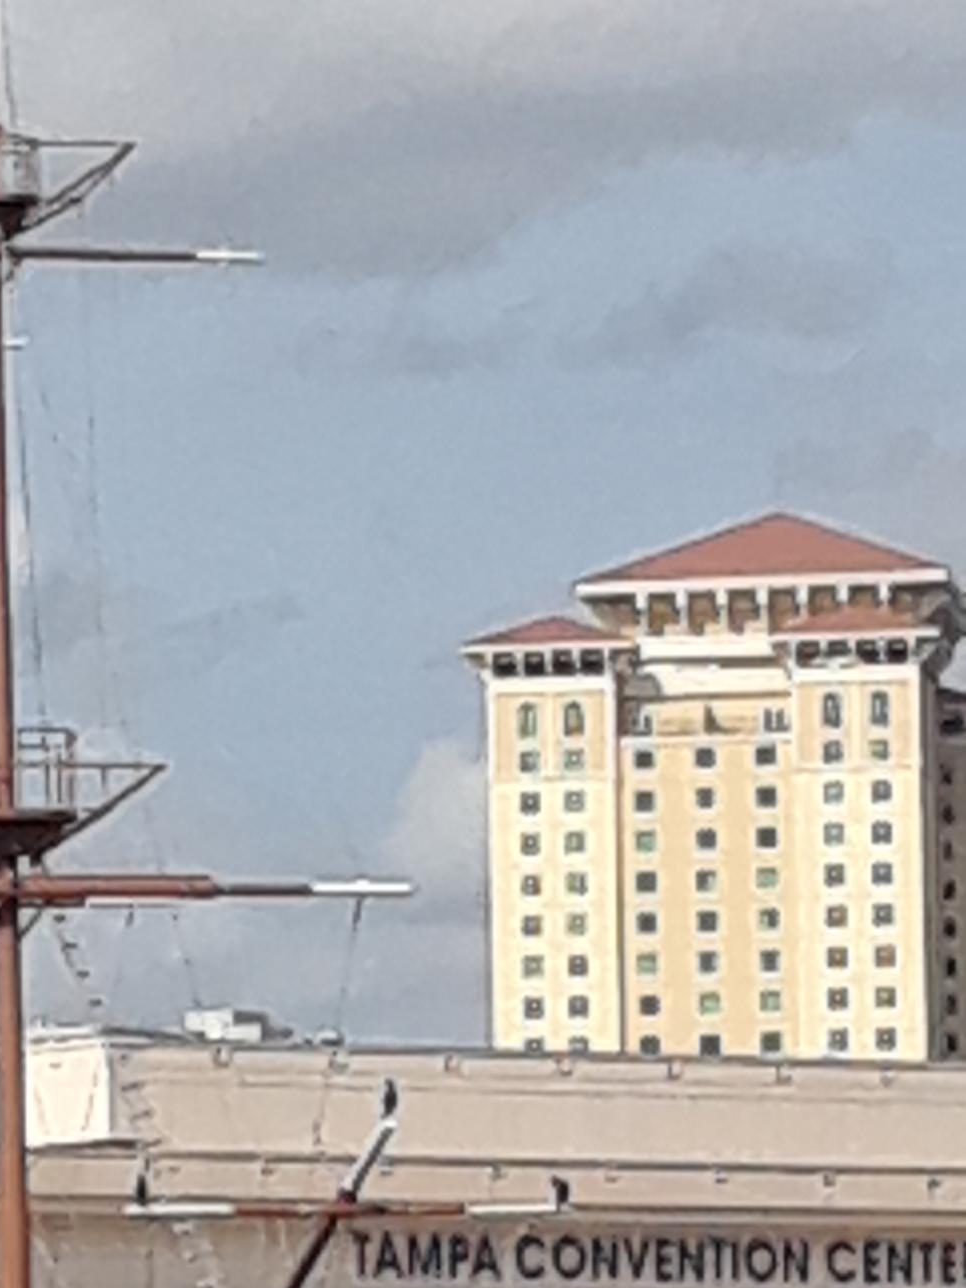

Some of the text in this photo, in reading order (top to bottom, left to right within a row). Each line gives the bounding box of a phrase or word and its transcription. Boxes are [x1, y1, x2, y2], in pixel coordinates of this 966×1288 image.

[352, 1231, 966, 1286] TAMPA CONVENTION CENTE
